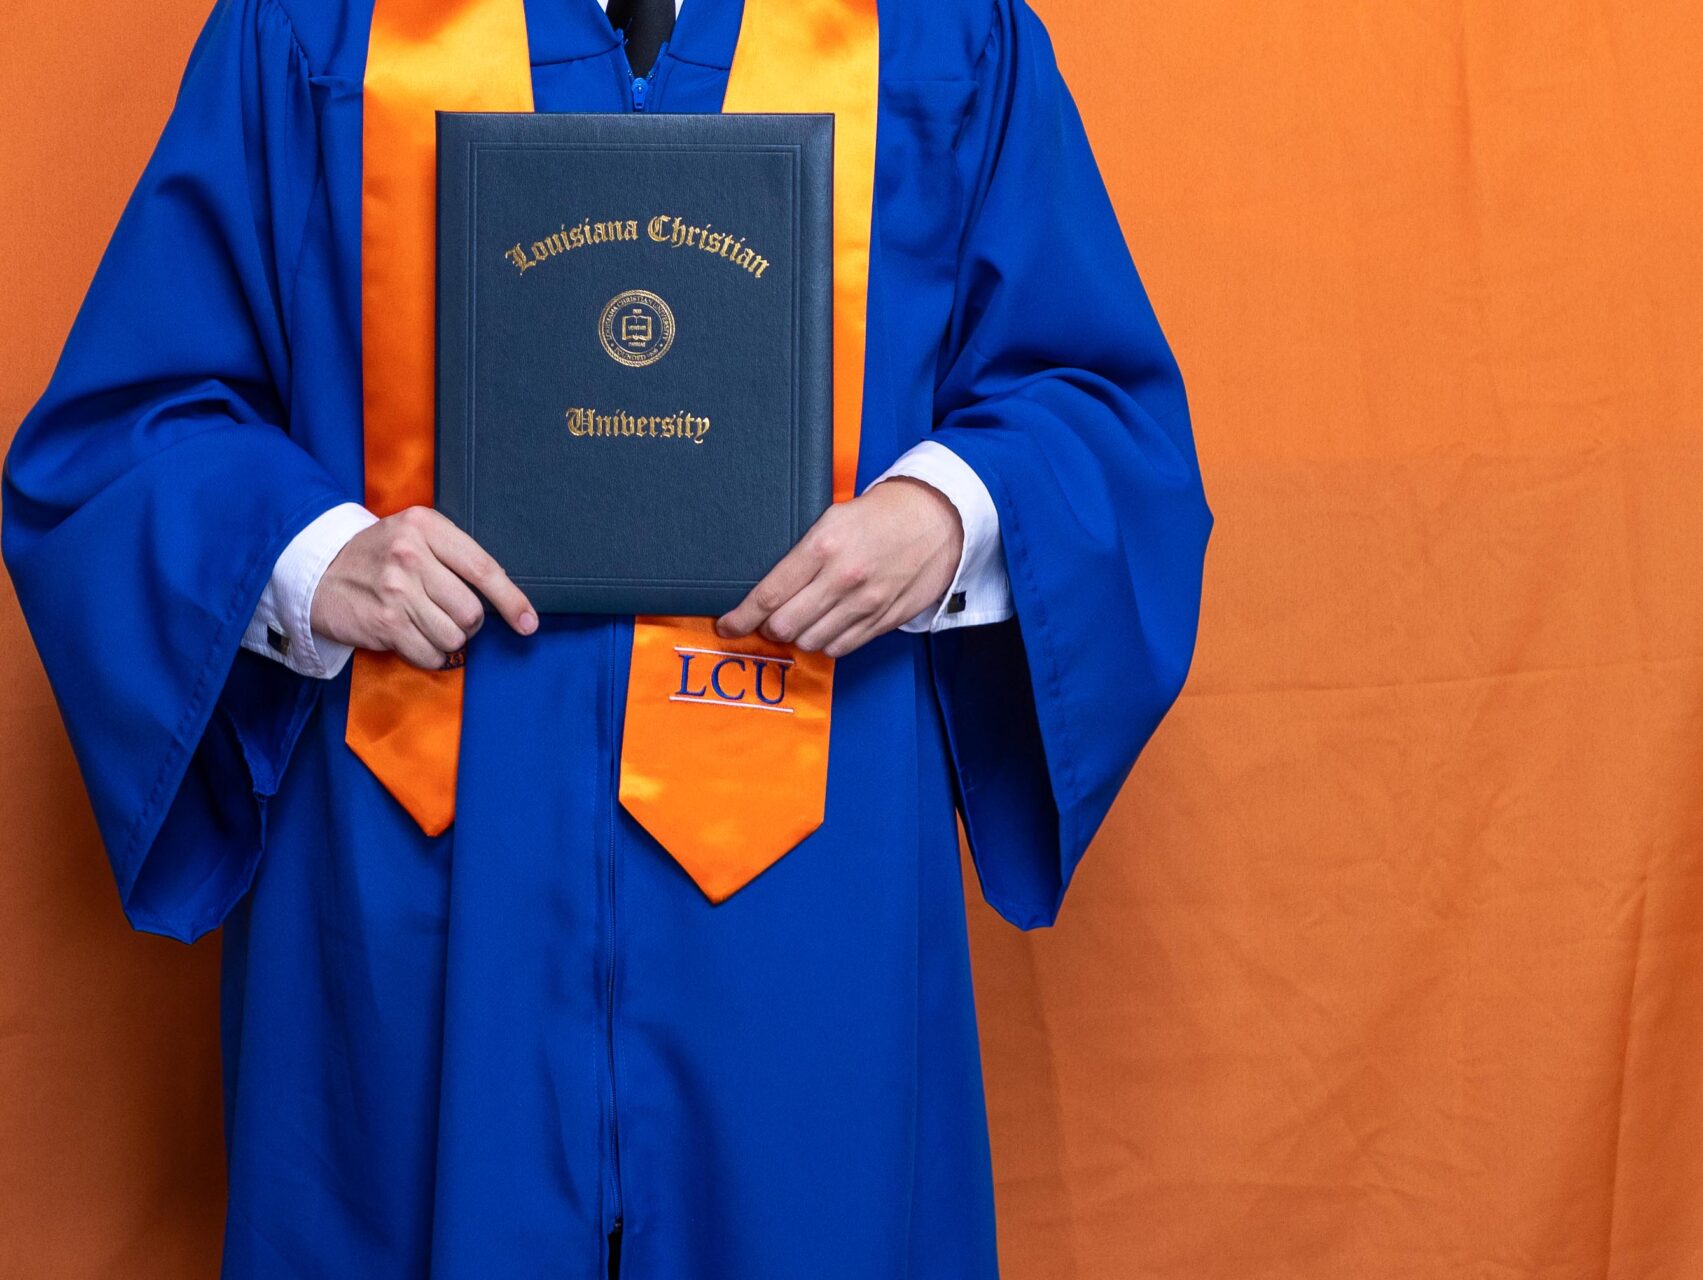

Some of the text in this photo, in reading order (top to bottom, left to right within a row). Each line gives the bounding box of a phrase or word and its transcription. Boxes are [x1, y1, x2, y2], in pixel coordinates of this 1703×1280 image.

[505, 214, 770, 278] Louisiana Christian
[565, 406, 711, 444] University
[675, 653, 792, 705] LCU
